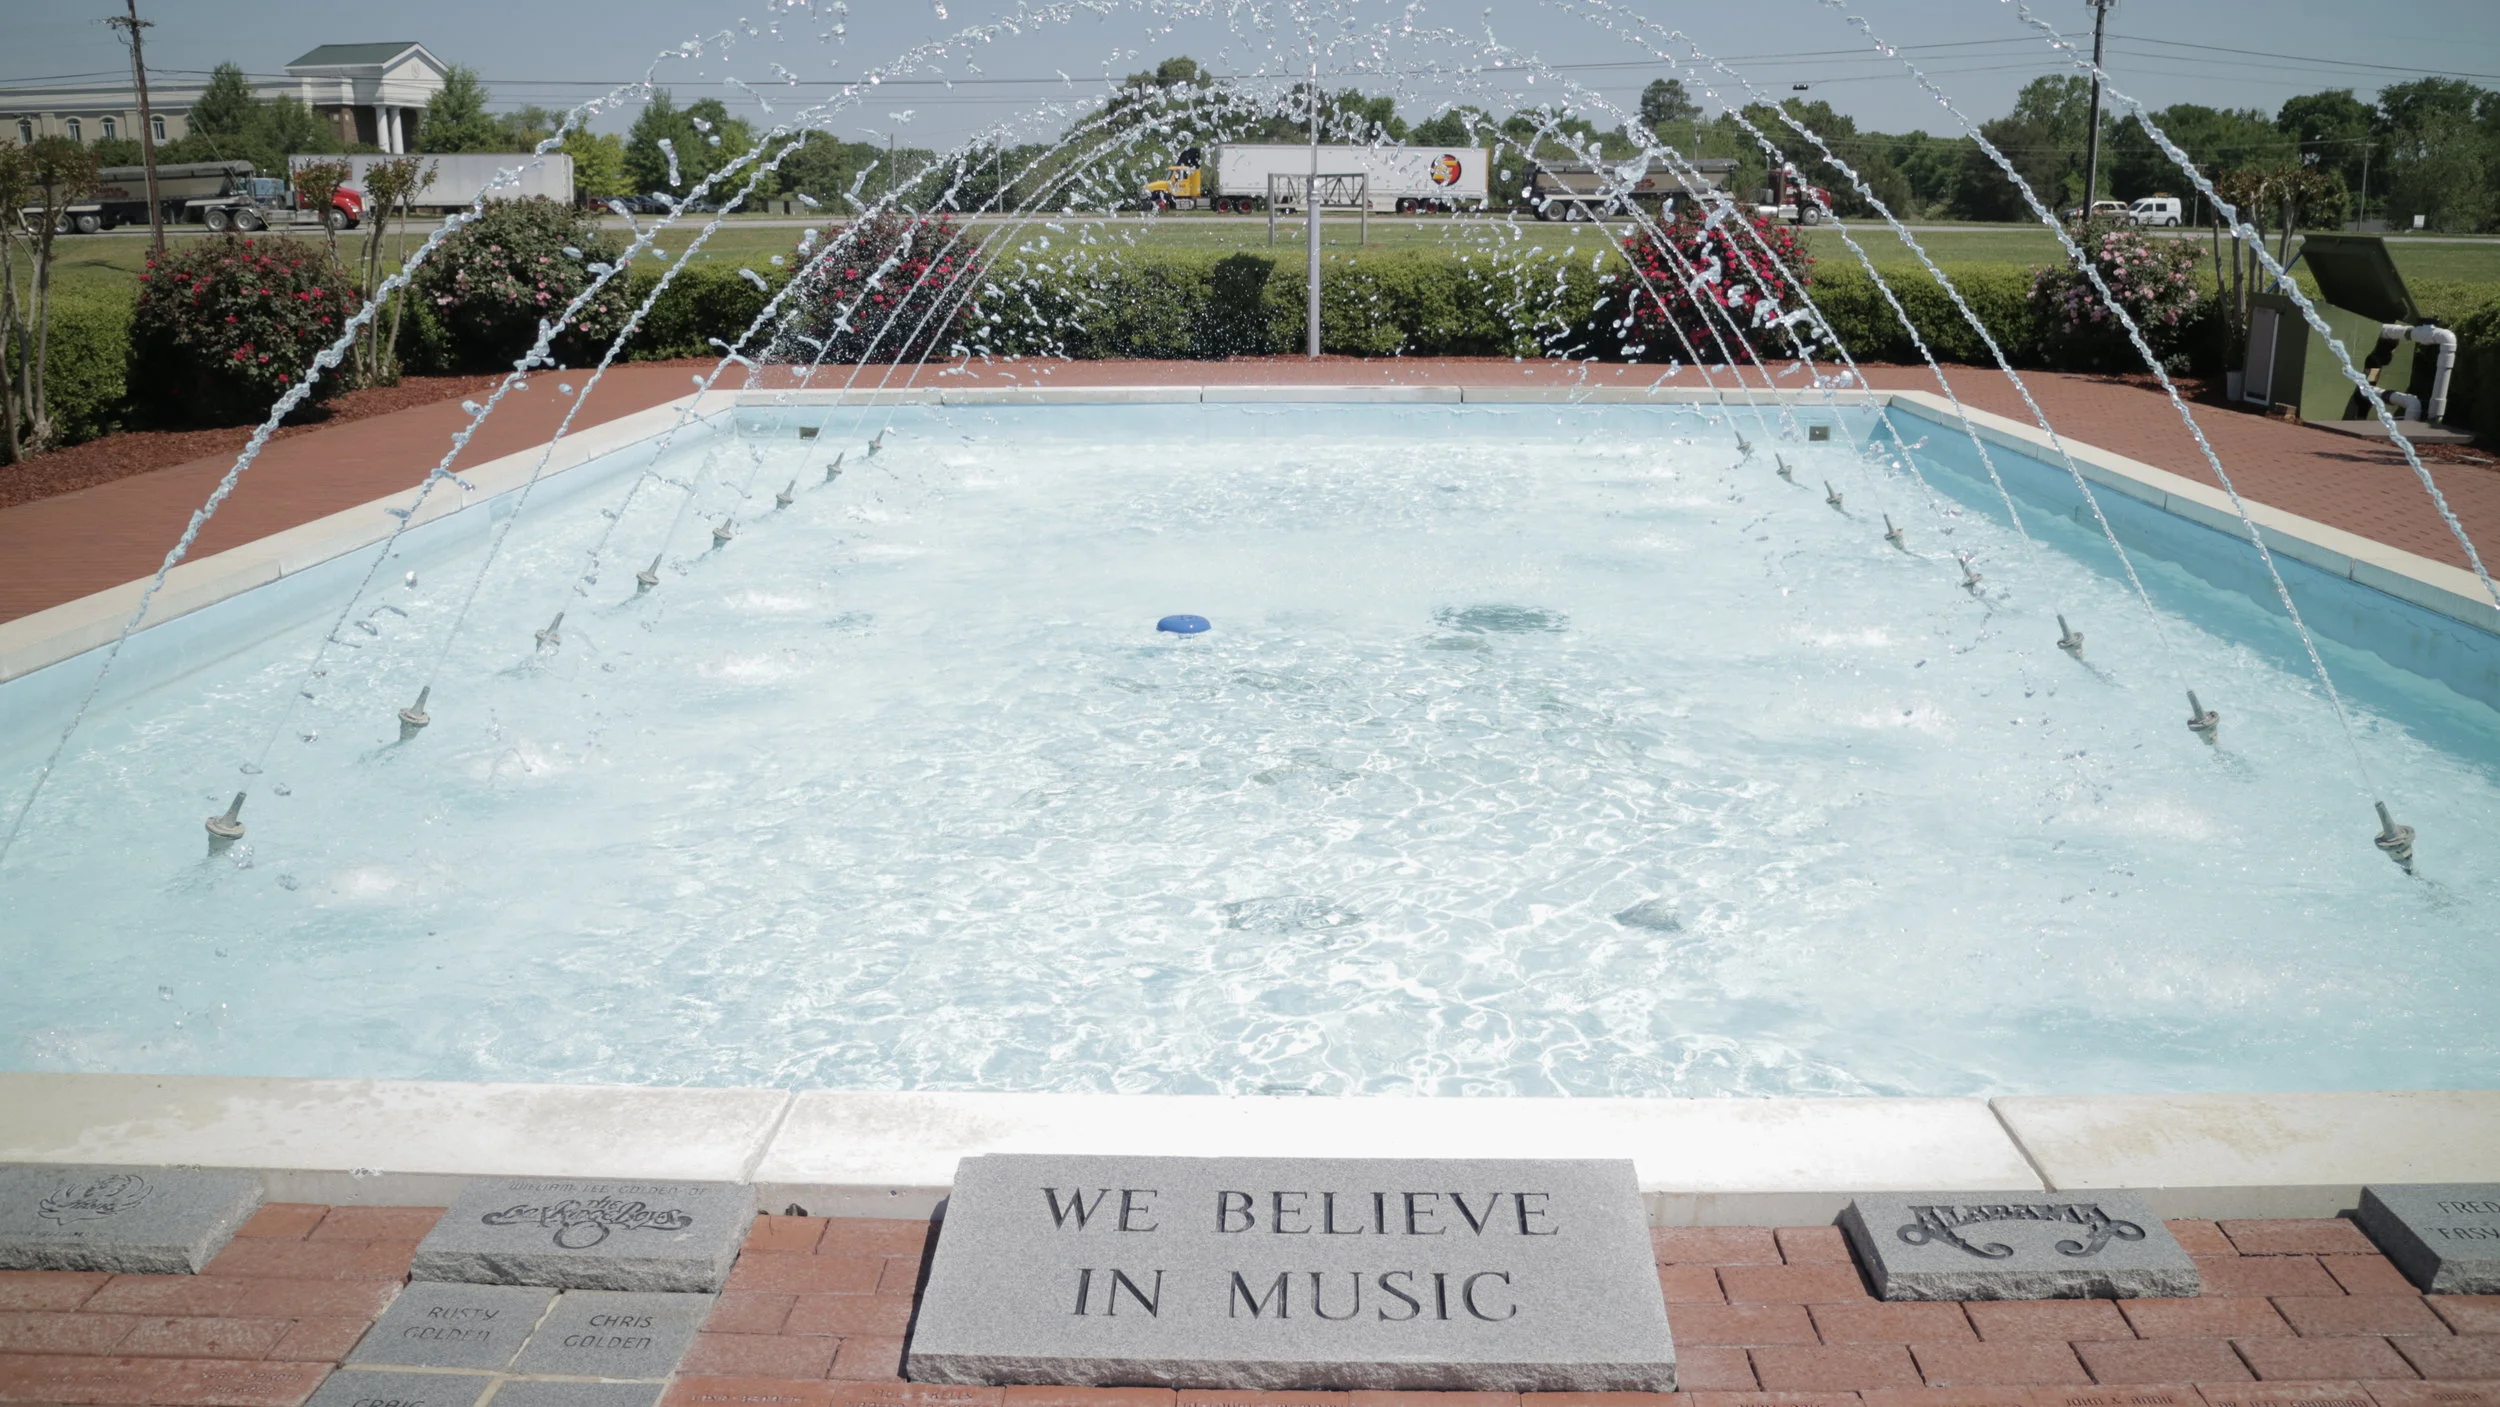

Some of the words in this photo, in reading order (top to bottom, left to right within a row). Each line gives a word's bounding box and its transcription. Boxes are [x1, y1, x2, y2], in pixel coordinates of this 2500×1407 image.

[618, 1184, 678, 1196] GOLDEN
[1039, 1187, 1160, 1233] WE
[1209, 1189, 1560, 1237] BELIEVE
[1072, 1267, 1164, 1319] IN
[1227, 1269, 1518, 1323] MUSIC
[426, 1306, 500, 1321] RUSTY
[589, 1313, 654, 1329] CHRIS
[403, 1326, 491, 1343] GOLDEN
[563, 1334, 651, 1351] GOLDEN
